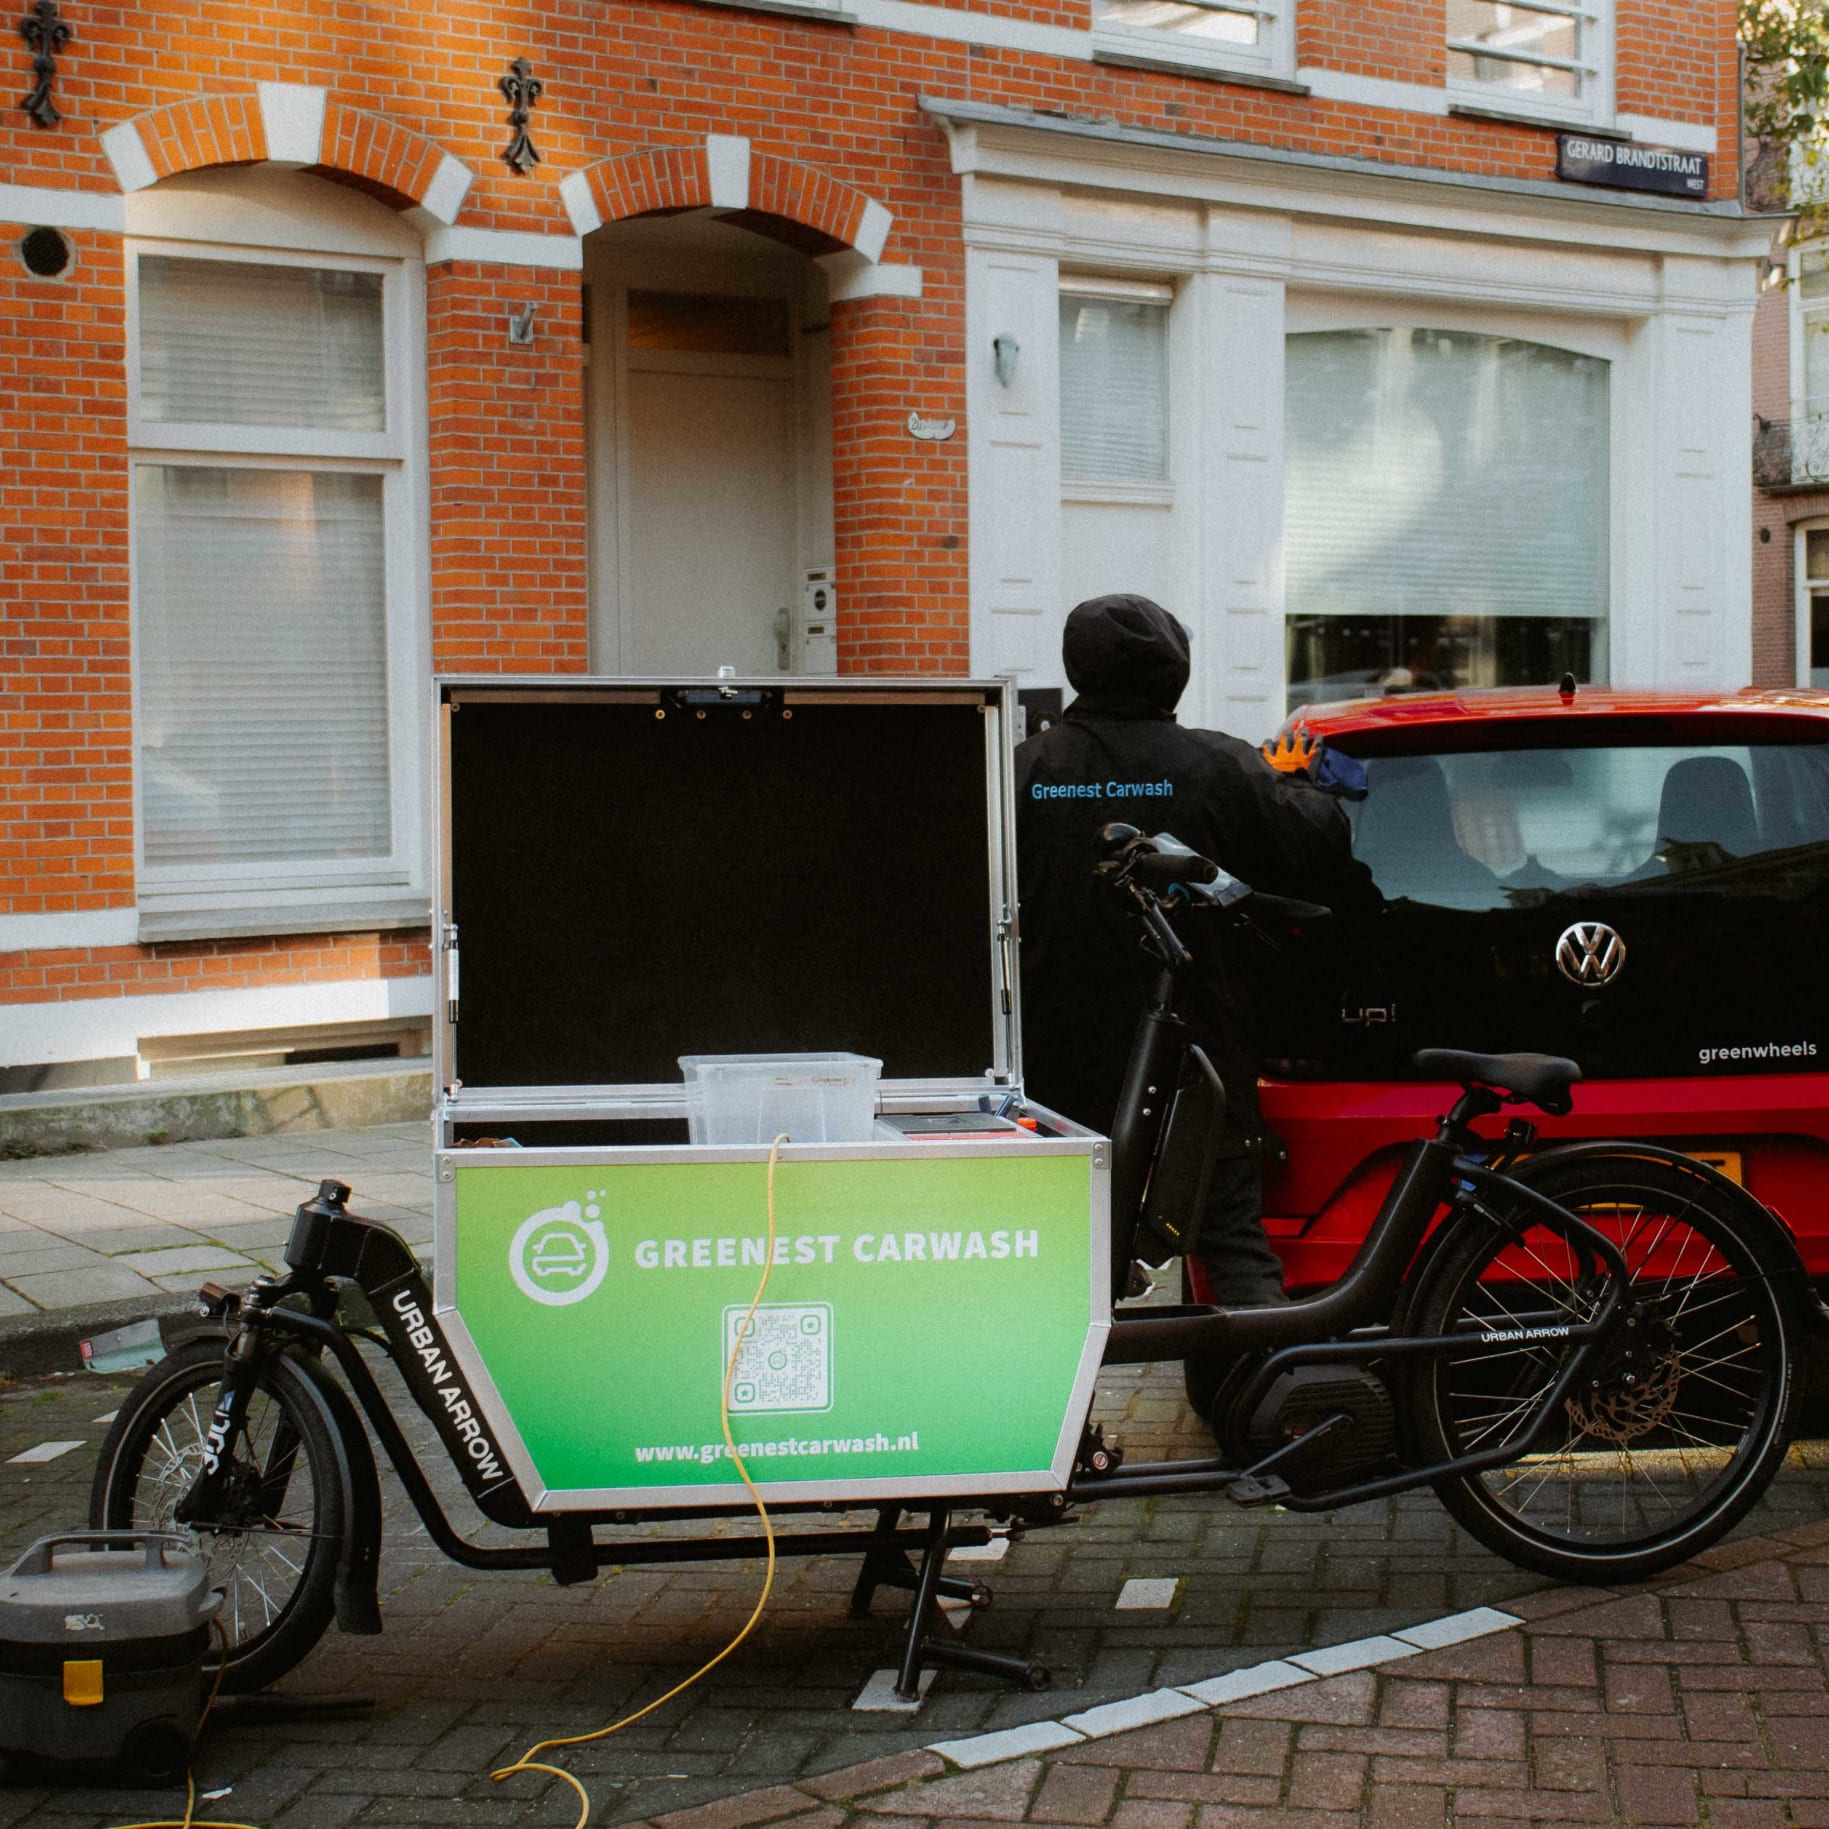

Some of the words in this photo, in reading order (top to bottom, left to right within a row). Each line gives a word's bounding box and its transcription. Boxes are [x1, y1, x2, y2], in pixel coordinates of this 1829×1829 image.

[1567, 140, 1614, 163] GERARD
[1616, 147, 1701, 175] BRANDTSTRAAT
[1687, 178, 1704, 190] WEST
[1032, 783, 1102, 800] Greenest
[1106, 779, 1174, 798] Carwash
[1698, 1040, 1818, 1065] greenwheels
[634, 1234, 841, 1269] GREENEST
[853, 1229, 1040, 1262] CARWASH
[1481, 1331, 1524, 1342] URBAN
[1526, 1327, 1569, 1339] ARROW
[392, 1289, 453, 1385] URBAN
[438, 1387, 504, 1480] ARROW
[634, 1431, 919, 1464] www.greenestcarwash.nl
